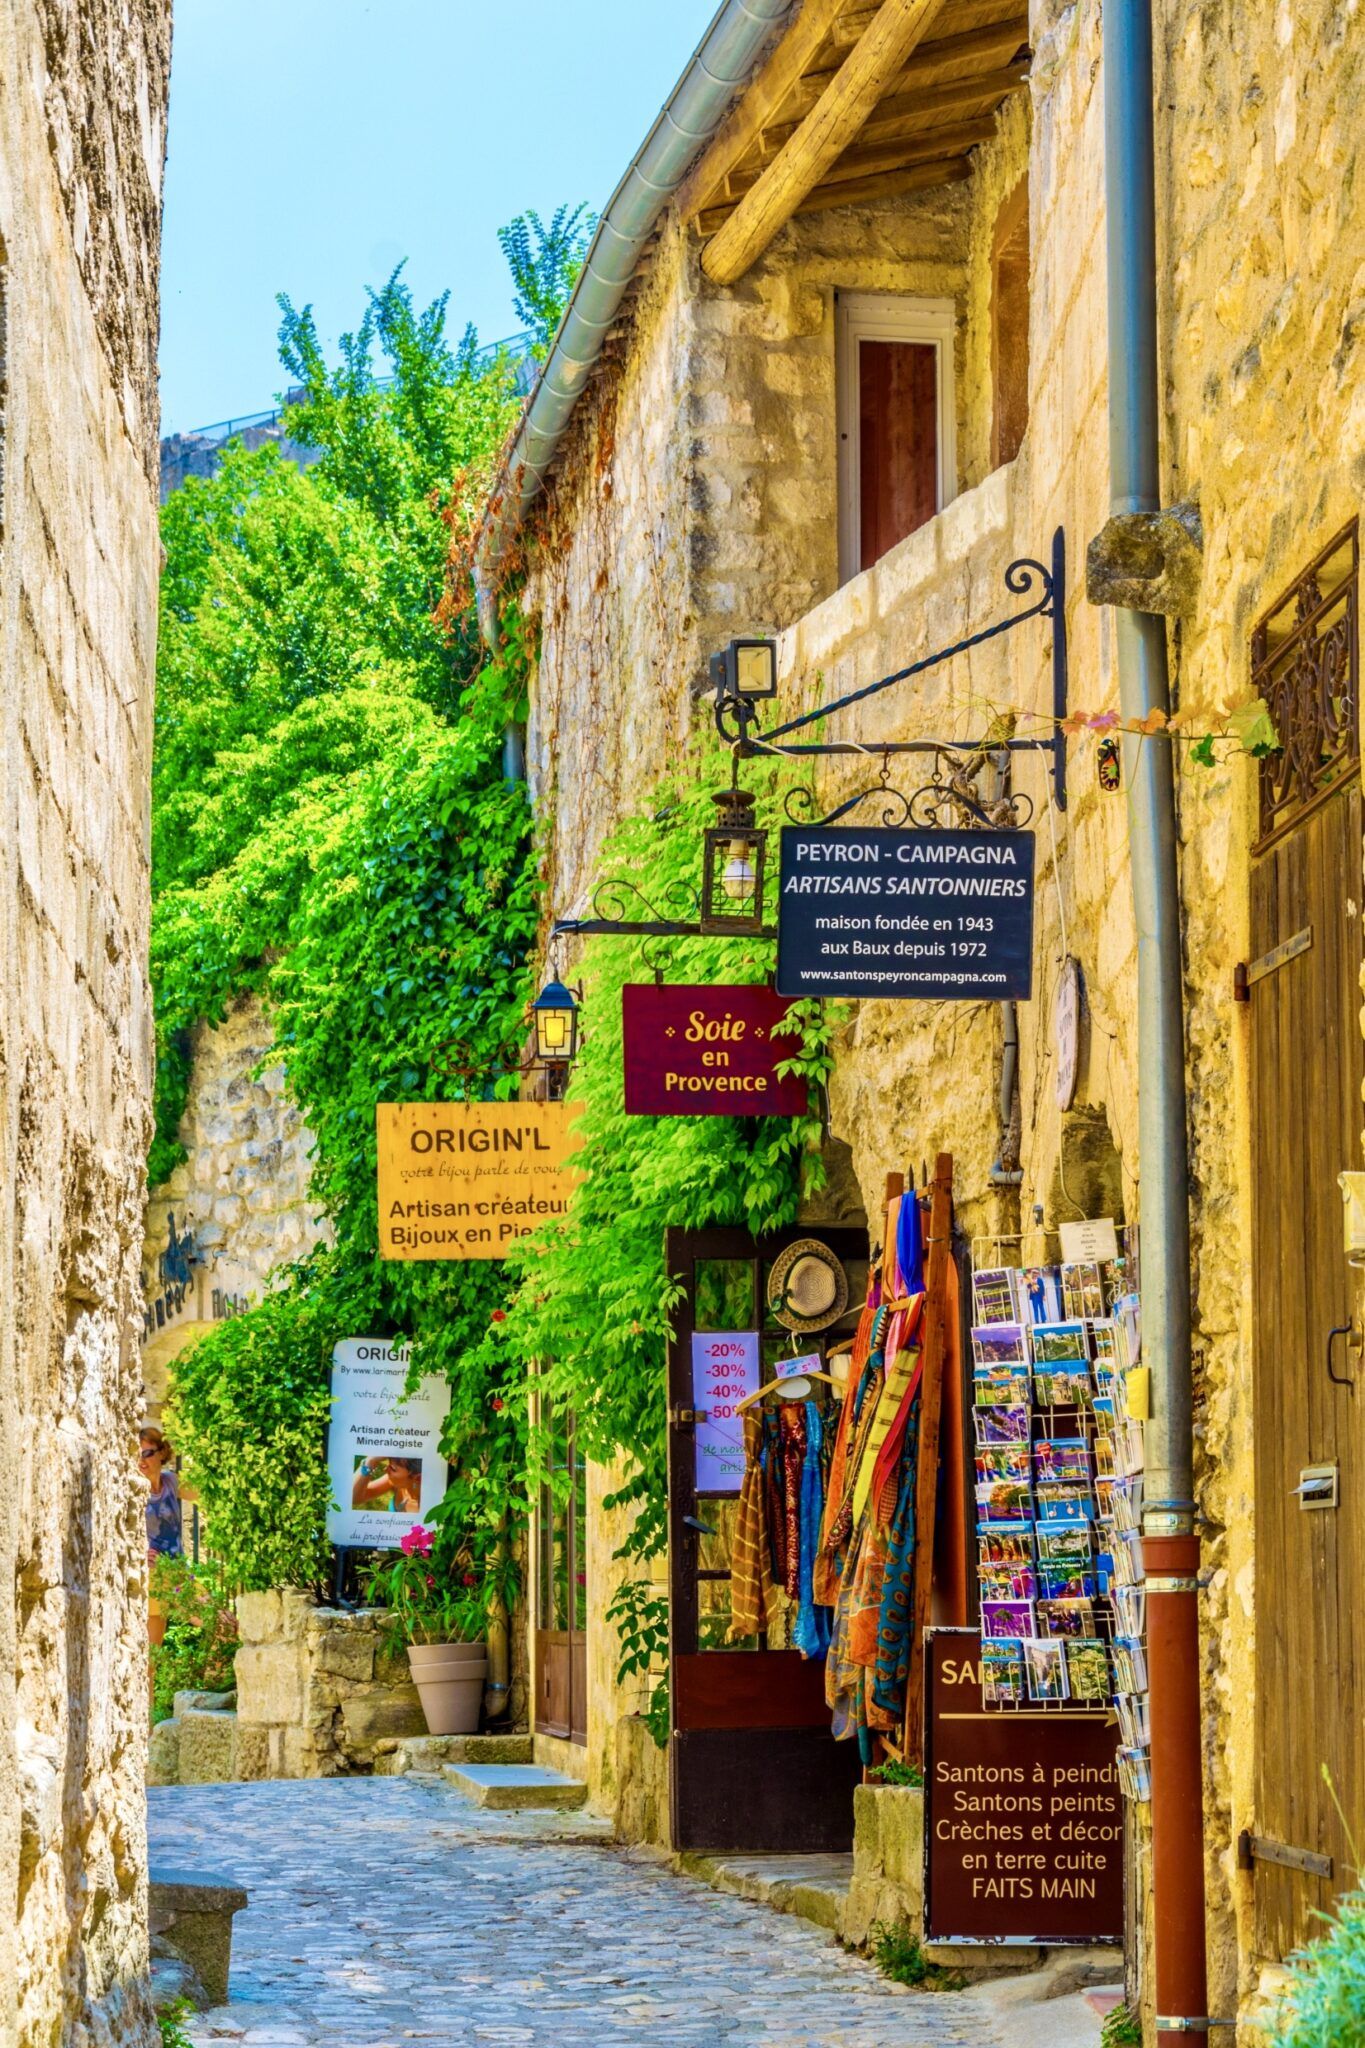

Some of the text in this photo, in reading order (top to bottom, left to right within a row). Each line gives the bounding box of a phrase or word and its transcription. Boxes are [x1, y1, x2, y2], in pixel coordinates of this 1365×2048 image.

[796, 844, 879, 862] PEYRON
[897, 845, 1016, 864] CAMPAGNA
[784, 876, 1026, 897] ARTISANS SANTONNIERS
[815, 915, 993, 931] maison fondée en 1943
[821, 941, 987, 959] aux Baux depuis 1972
[800, 969, 1007, 983] www.santonspeyroncampagna.com
[685, 1011, 746, 1042] Soie
[702, 1051, 729, 1066] en
[665, 1072, 767, 1092] Provence
[410, 1127, 550, 1153] ORIGIN'L
[400, 1166, 433, 1178] votre
[438, 1161, 470, 1182] bijou
[474, 1159, 509, 1180] parle
[514, 1160, 529, 1175] de
[390, 1199, 470, 1218] Artisan
[391, 1224, 459, 1248] Bijoux
[465, 1228, 491, 1243] en
[704, 1343, 745, 1357] -20%
[340, 1365, 351, 1375] By
[705, 1363, 746, 1378] -30%
[380, 1386, 401, 1402] bijo
[406, 1389, 431, 1402] arle
[706, 1384, 746, 1398] -40%
[350, 1424, 386, 1435] Artisan
[936, 1761, 1119, 1787] Santons à peindr
[953, 1790, 1115, 1816] Santons peints
[936, 1820, 1023, 1841] Crèches
[1031, 1822, 1052, 1841] et
[962, 1850, 1107, 1870] en terre cuite
[972, 1878, 1095, 1899] FAITS MAIN
